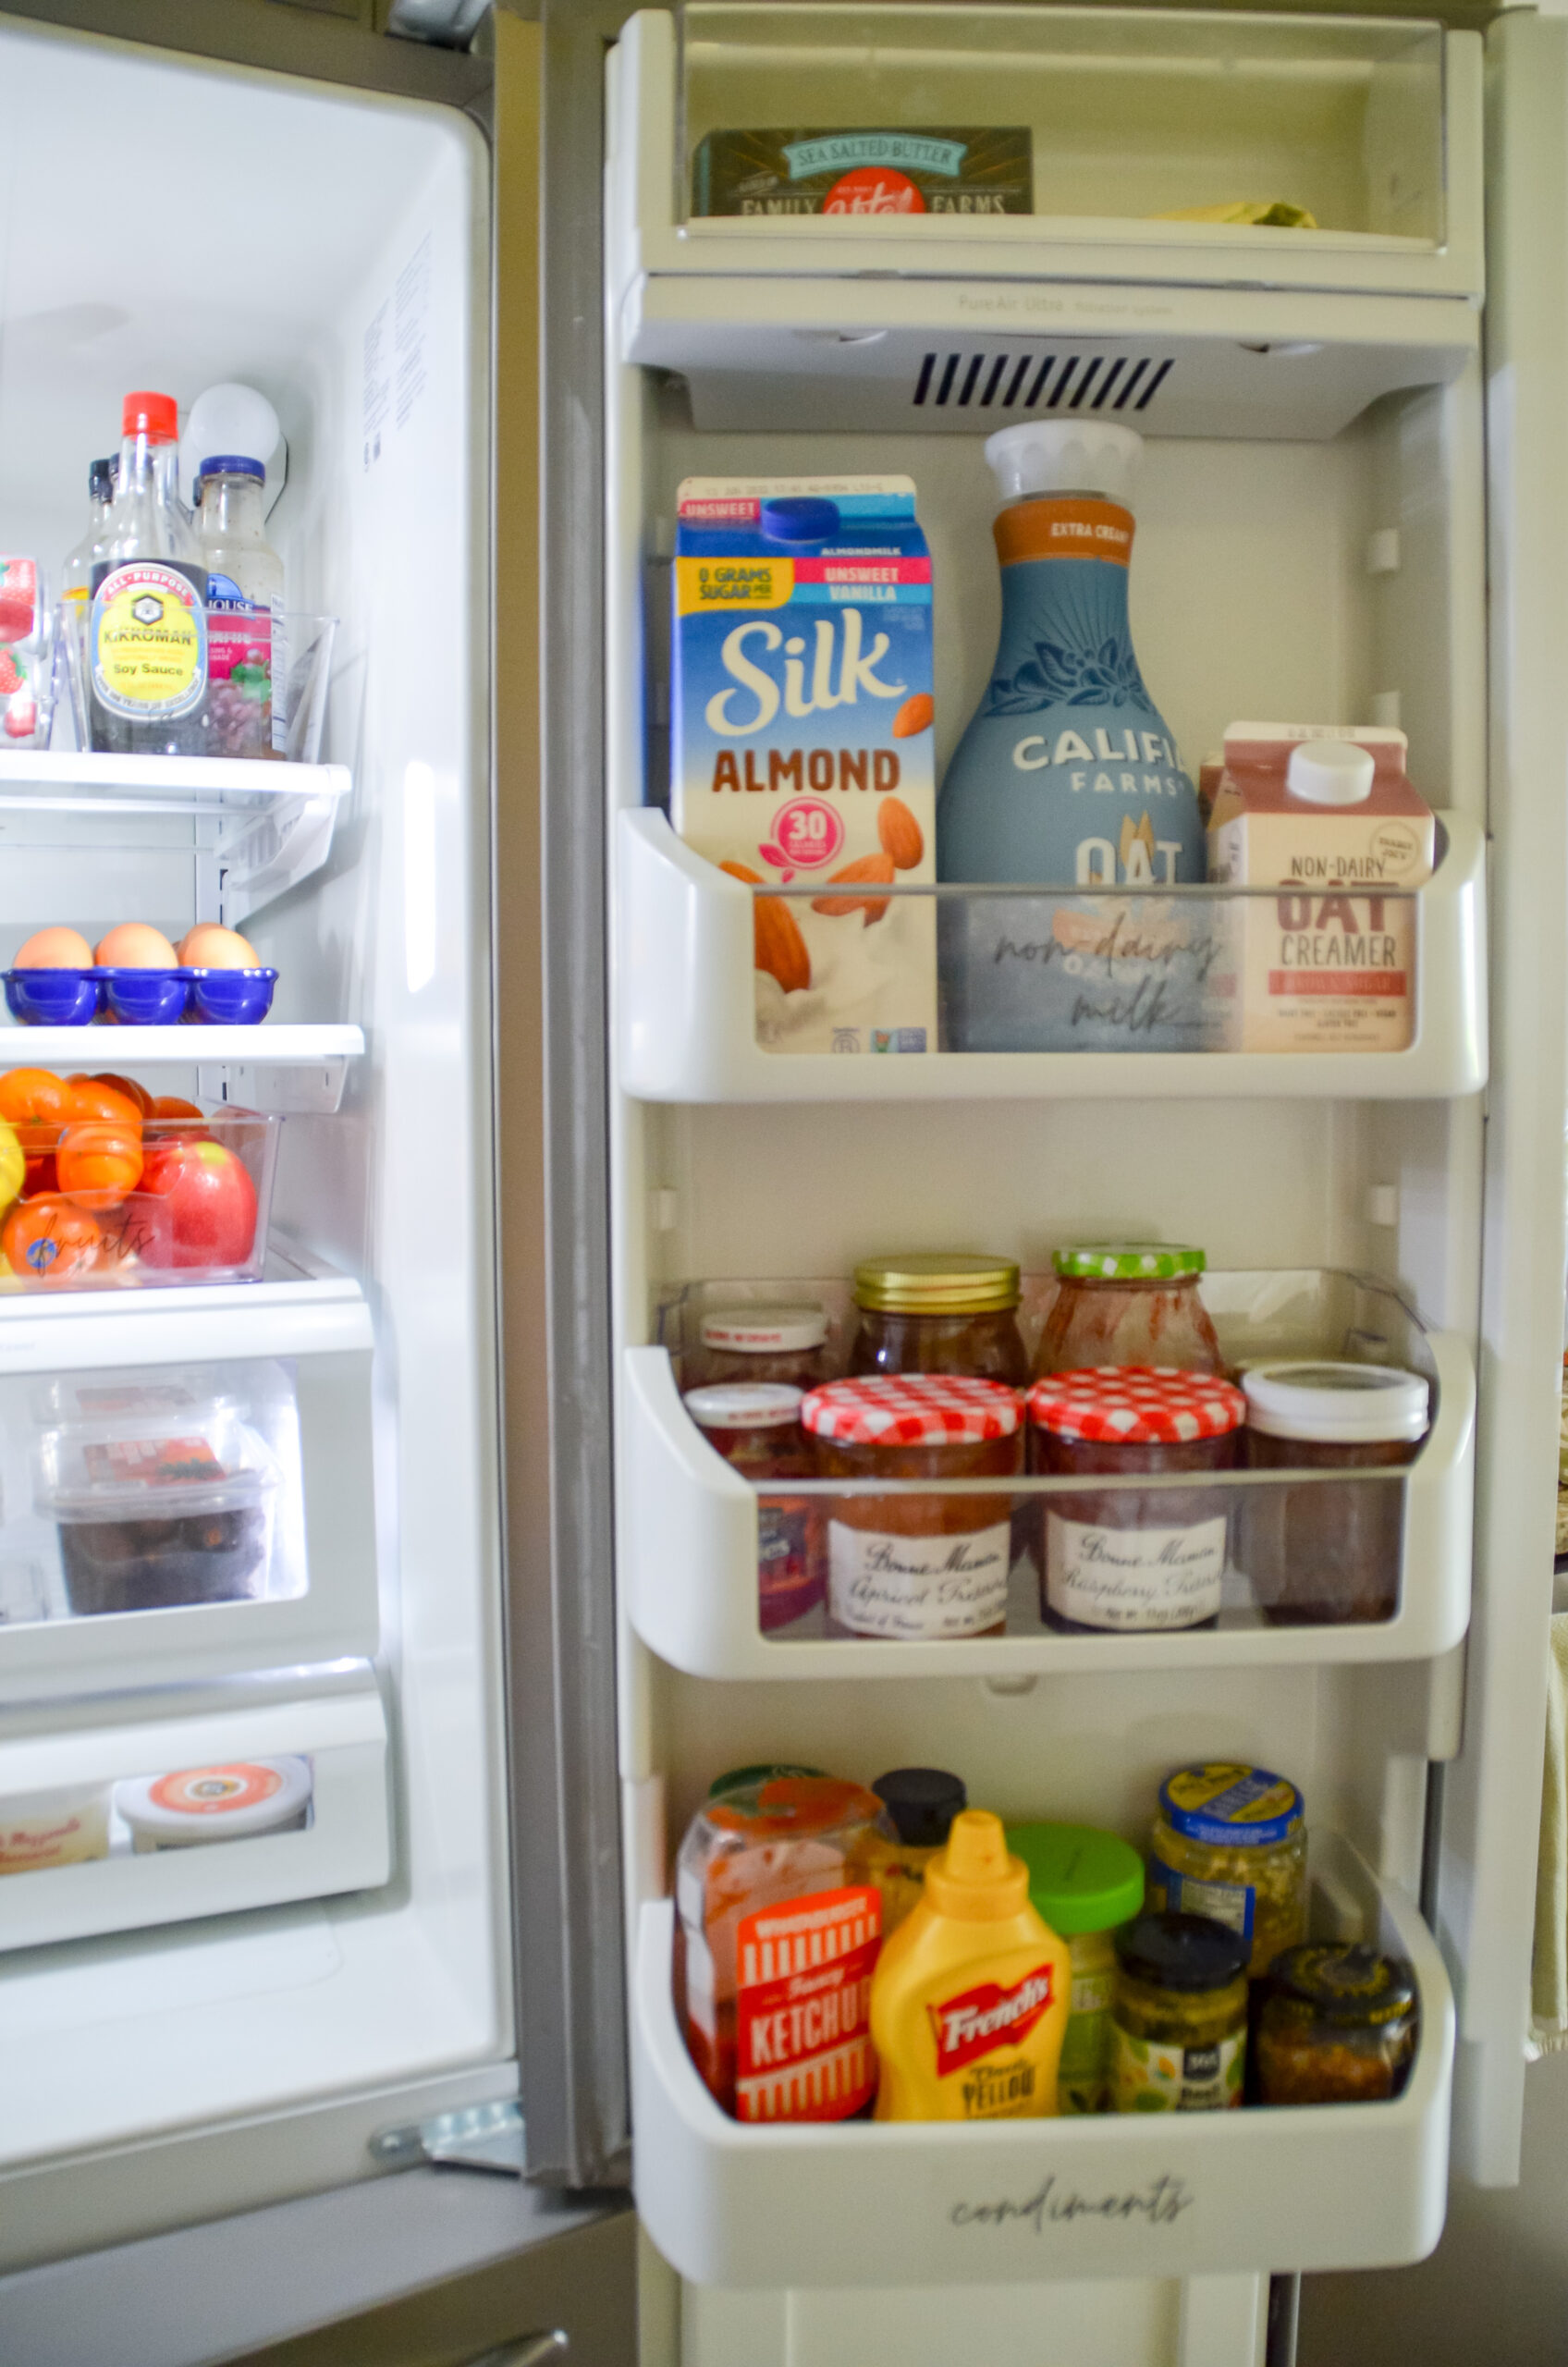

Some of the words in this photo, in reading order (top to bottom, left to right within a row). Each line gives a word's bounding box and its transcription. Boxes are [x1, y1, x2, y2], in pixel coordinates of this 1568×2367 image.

[797, 146, 828, 166] SEA
[830, 140, 888, 159] SALTED
[891, 141, 952, 165] BUTTER
[932, 195, 1005, 214] FARMS
[685, 501, 754, 517] UNSWEET
[1051, 522, 1093, 536] EXTRA
[715, 567, 772, 583] GRAMS
[825, 567, 898, 583] UNSWEET
[700, 583, 752, 600] SUGAR
[829, 585, 897, 602] VANILLA
[104, 629, 192, 645] KIKKOMAN
[114, 664, 138, 675] Soy
[141, 663, 184, 676] Sauce
[705, 607, 908, 736] Silk
[712, 749, 900, 792] ALMOND
[1070, 772, 1177, 796] FARMS
[789, 810, 827, 840] 30
[1075, 837, 1183, 884] OAT
[1292, 856, 1387, 879] NON-DAIRY
[1277, 879, 1400, 934] OAT
[1280, 934, 1397, 967] CREAMER
[1080, 1533, 1142, 1567] Bonne
[1062, 1568, 1158, 1605] Raspberry
[945, 1976, 1050, 2054] French's
[962, 2067, 1035, 2116] YELLOW
[949, 2174, 1195, 2234] condiments
